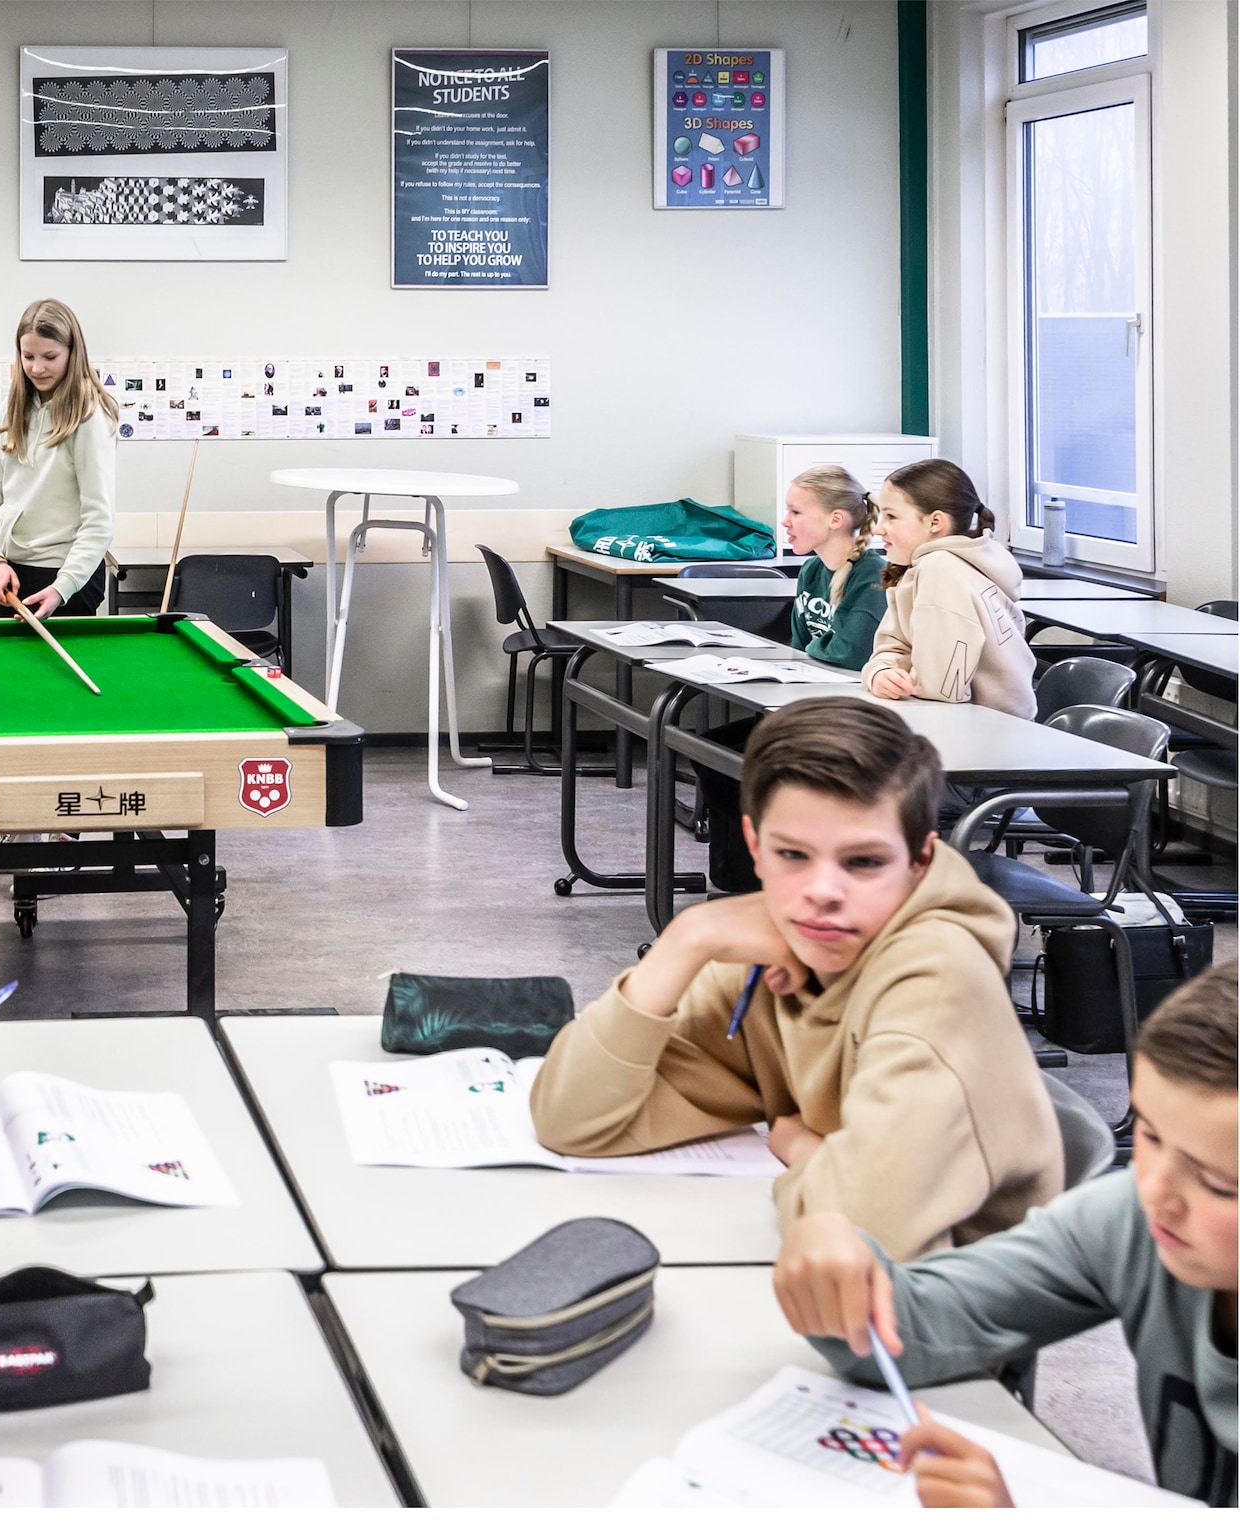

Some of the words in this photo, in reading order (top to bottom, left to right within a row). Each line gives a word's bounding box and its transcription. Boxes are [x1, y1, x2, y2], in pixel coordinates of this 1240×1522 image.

[685, 54, 702, 65] 2D
[706, 53, 754, 67] Shapes
[419, 69, 473, 87] NOTICE
[474, 67, 495, 83] TO
[497, 66, 526, 82] ALL
[432, 85, 511, 104] STUDENTS
[684, 118, 702, 130] 3D
[706, 118, 754, 132] Shapes
[431, 230, 447, 242] TO
[448, 230, 483, 242] TEACH
[484, 230, 509, 242] YOU
[428, 242, 444, 254] TO
[445, 242, 486, 254] INSPIRE
[487, 242, 511, 254] YOU
[417, 254, 433, 266] TO
[434, 254, 462, 266] HELP
[463, 254, 487, 266] YOU
[488, 254, 523, 266] GROW
[247, 773, 284, 785] KNBB
[54, 790, 147, 817] 星牌
